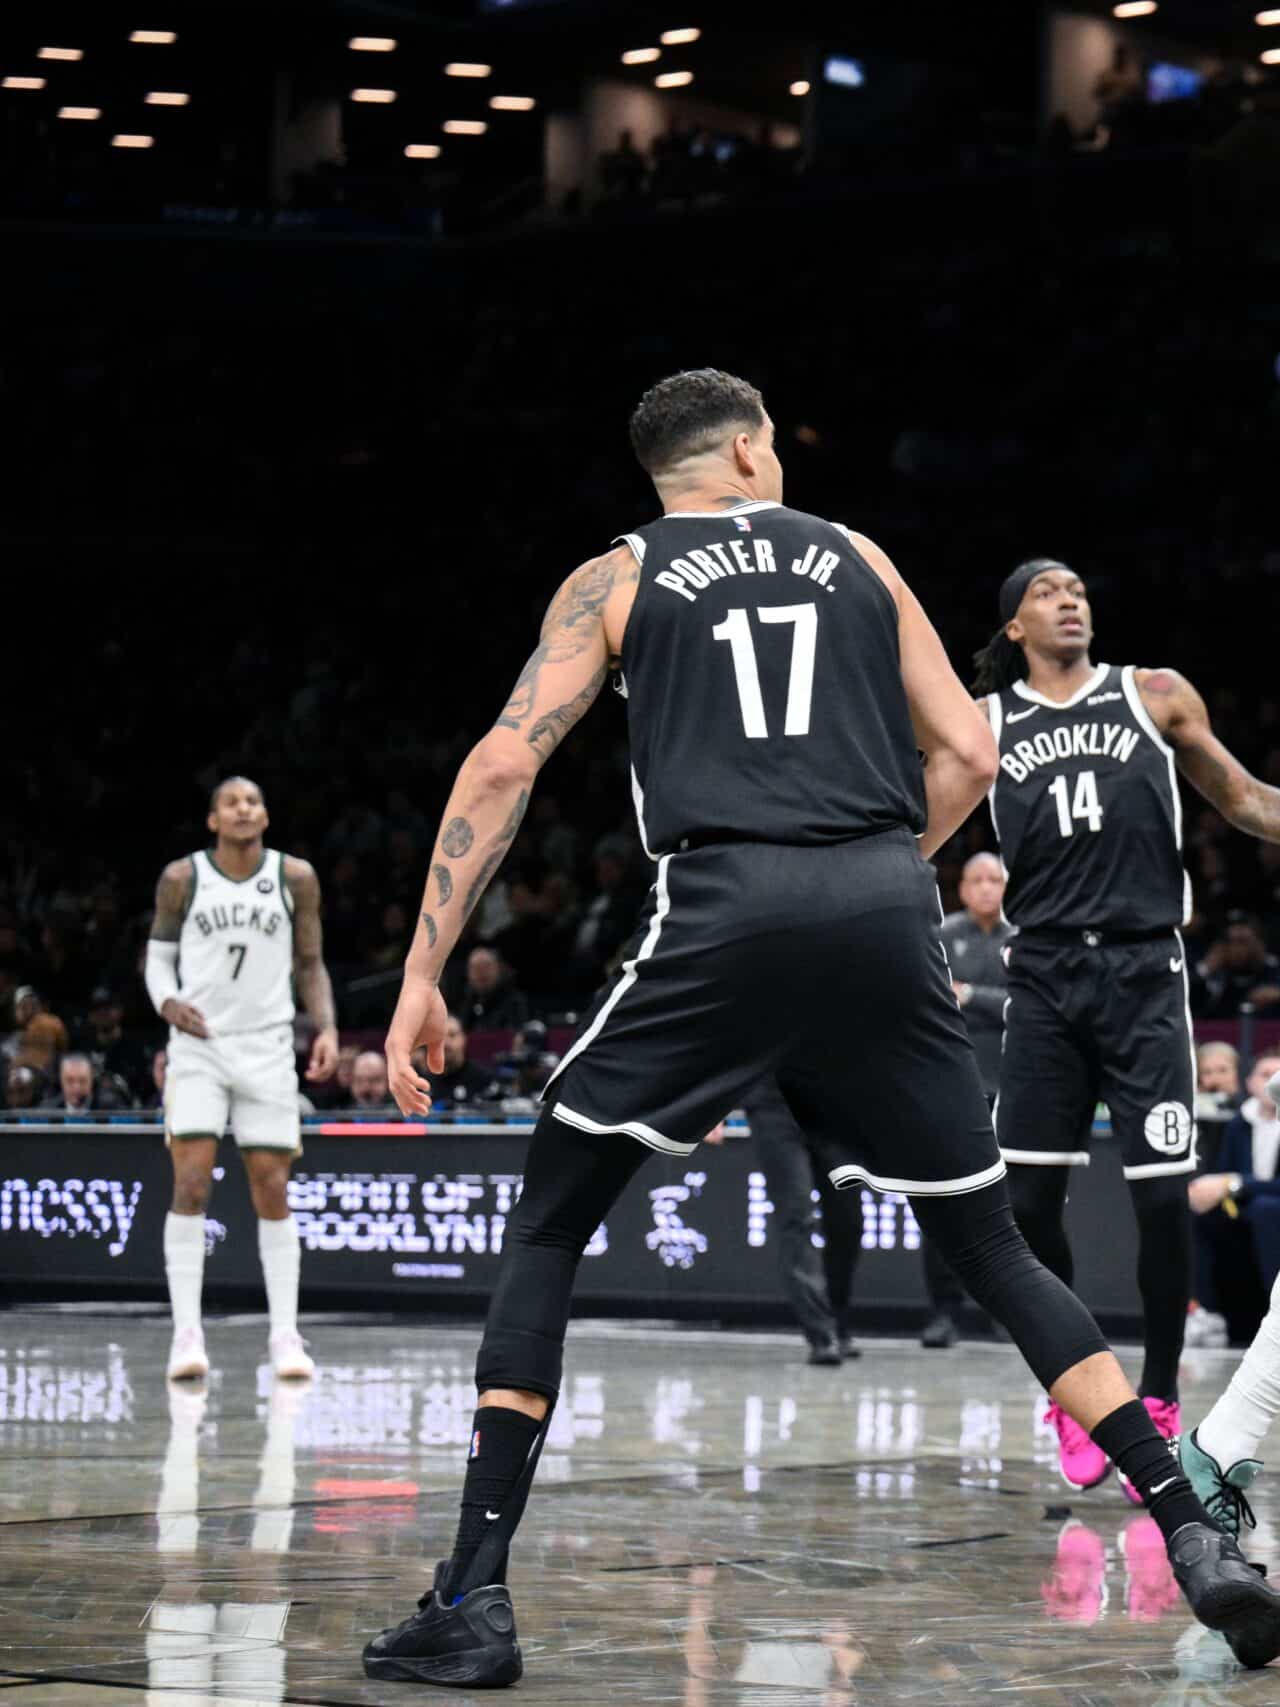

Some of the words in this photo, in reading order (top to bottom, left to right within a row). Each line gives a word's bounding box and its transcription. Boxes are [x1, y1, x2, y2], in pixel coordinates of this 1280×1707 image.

[654, 539, 776, 602] PORTER
[791, 544, 840, 593] JR.
[712, 602, 818, 738] 17
[999, 722, 1140, 783] BROOKLYN
[1048, 771, 1103, 837] 14
[194, 903, 282, 937] BUCKS
[228, 943, 247, 980] 7
[1164, 1110, 1180, 1145] B
